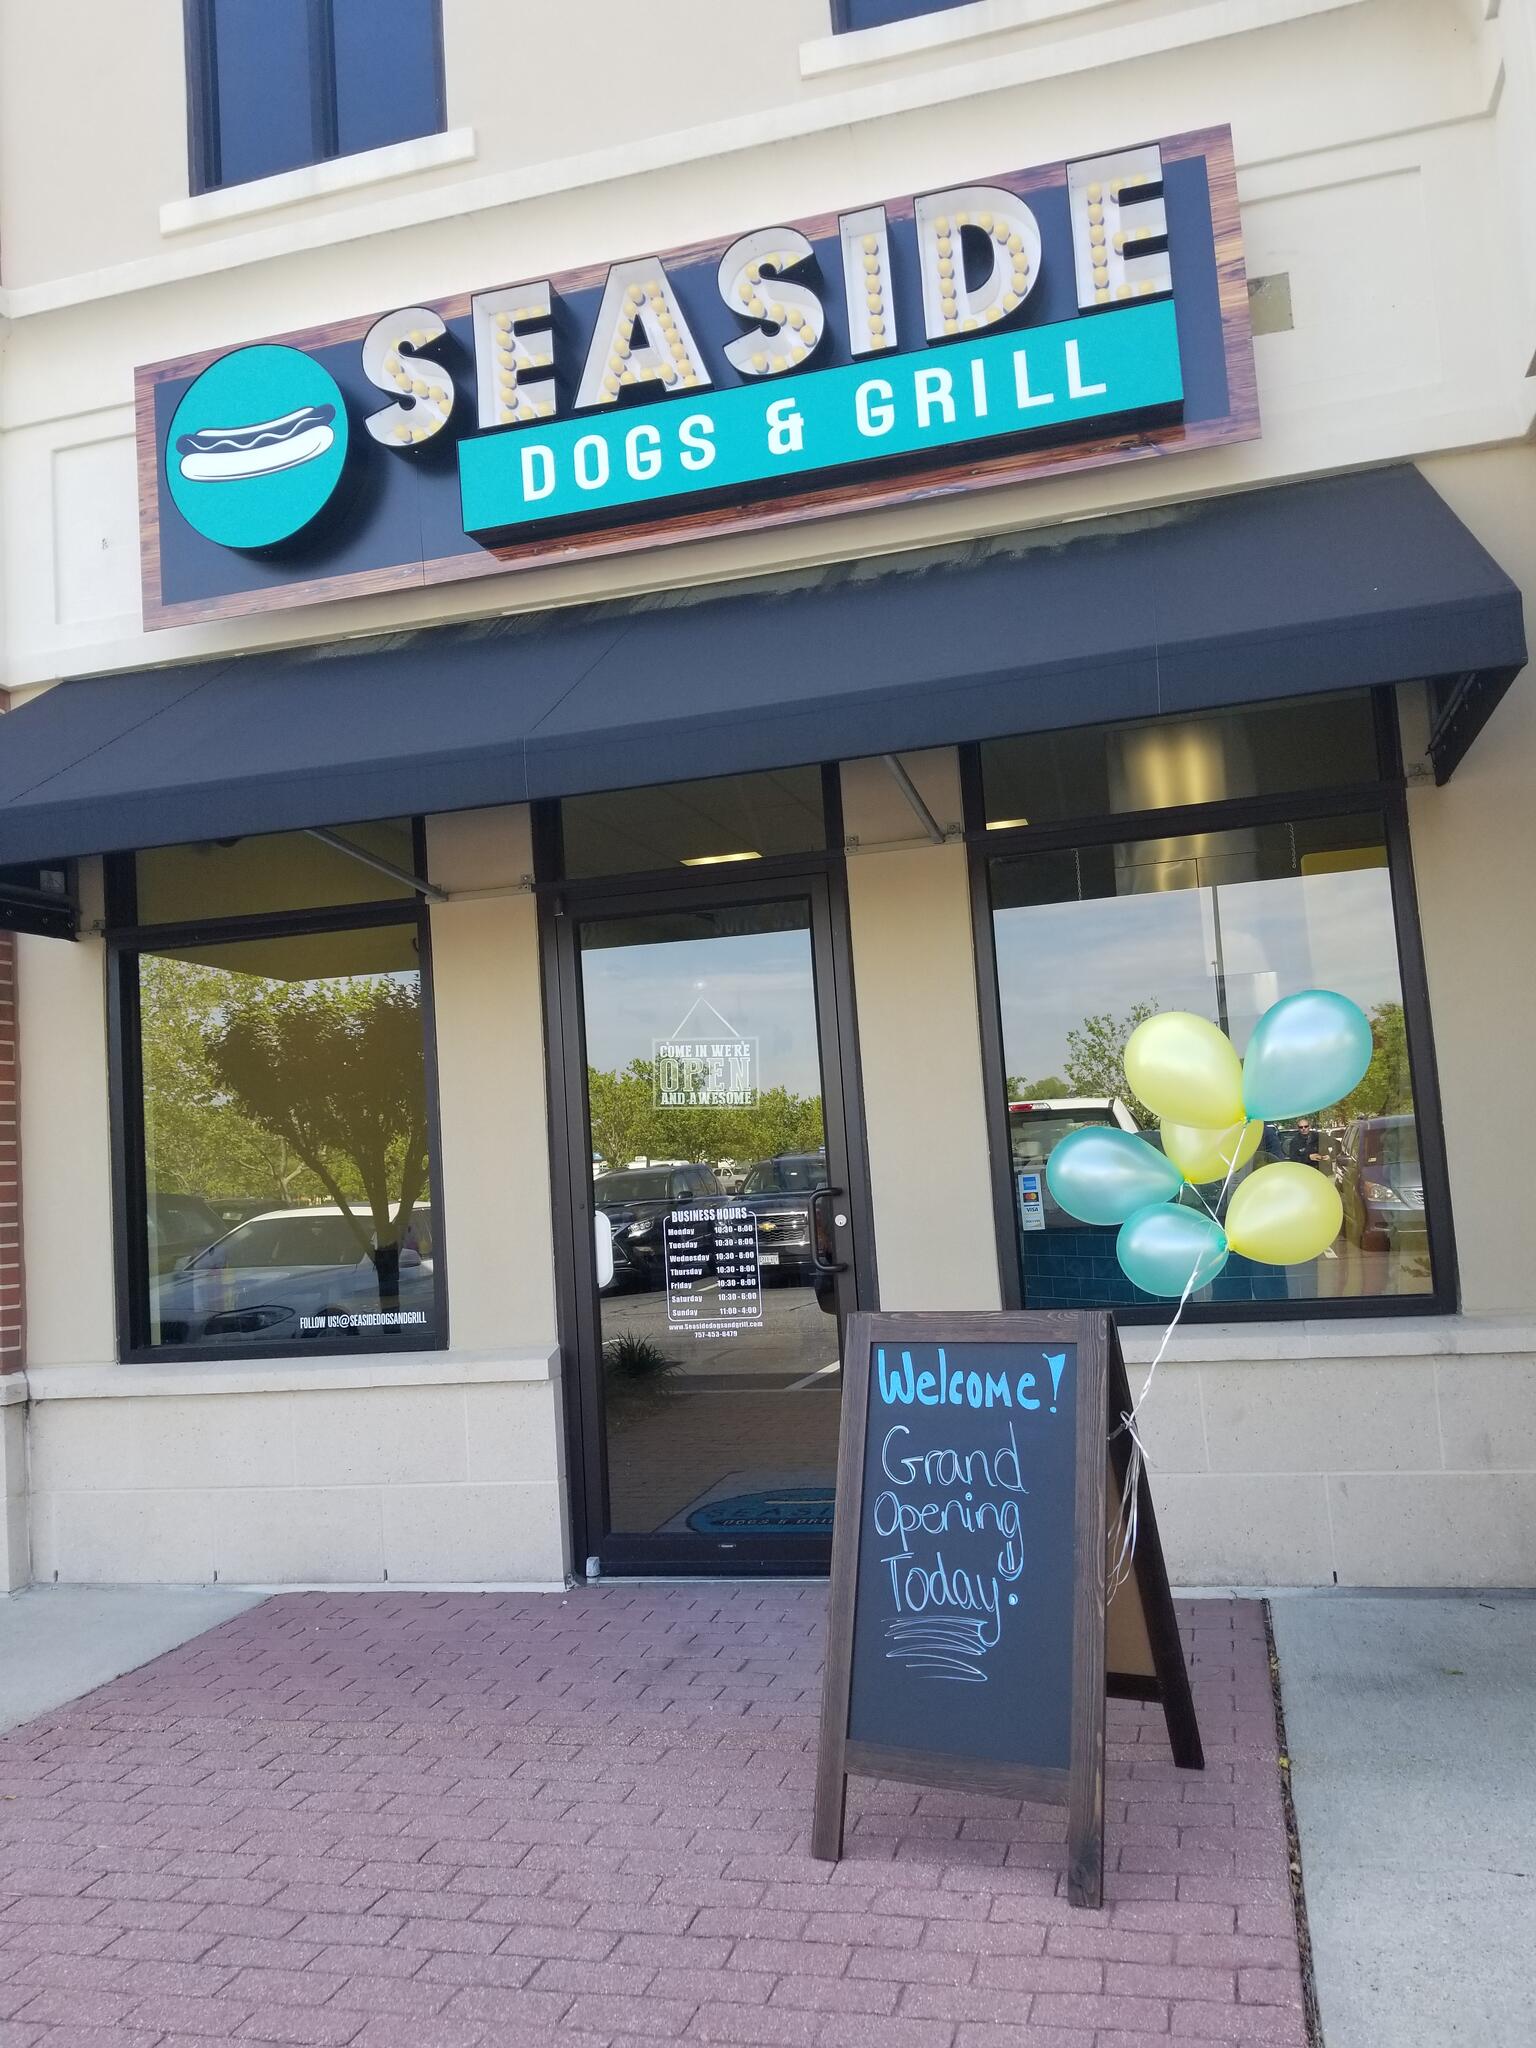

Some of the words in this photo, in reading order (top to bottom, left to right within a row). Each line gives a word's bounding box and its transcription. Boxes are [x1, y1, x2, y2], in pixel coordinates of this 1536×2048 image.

[362, 143, 1174, 447] SEASIDE
[520, 413, 716, 503] DOGS
[768, 397, 805, 454] &
[855, 340, 1108, 438] GRILL
[660, 1044, 692, 1058] COME
[695, 1044, 708, 1057] IN
[710, 1043, 751, 1057] WE'RE
[659, 1057, 751, 1092] OPEN
[661, 1092, 685, 1105] AND
[689, 1091, 752, 1104] AWESOME
[671, 1209, 716, 1223] BUSINESS
[716, 1207, 747, 1220] HOURS
[668, 1228, 695, 1236] Monday
[669, 1241, 698, 1249] Tuesday
[669, 1254, 710, 1263] Wednesday
[670, 1268, 703, 1276] Thursday
[670, 1282, 692, 1290] Friday
[671, 1295, 703, 1303] Saturday
[672, 1309, 698, 1317] Sunday
[300, 1316, 326, 1329] FOLLOW
[881, 1421, 1030, 1494] Grand
[874, 1491, 1024, 1581] Opening
